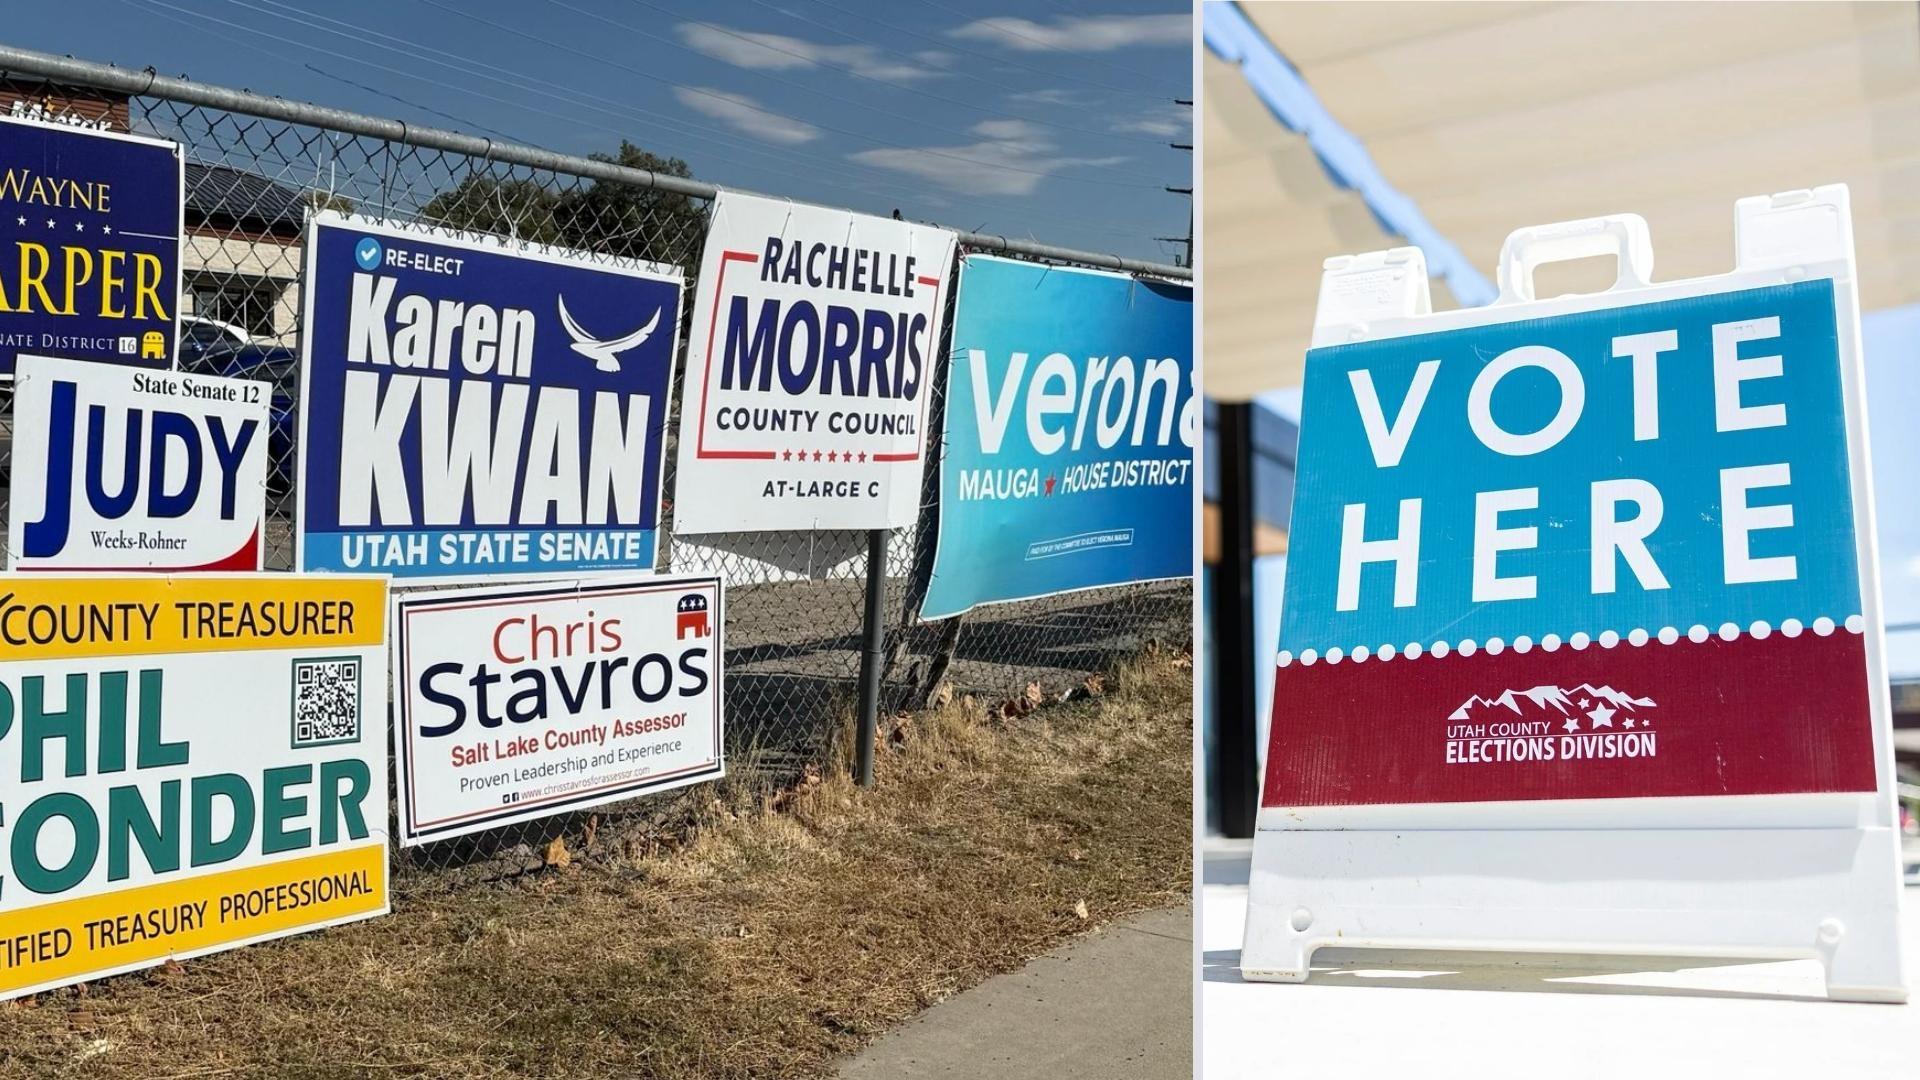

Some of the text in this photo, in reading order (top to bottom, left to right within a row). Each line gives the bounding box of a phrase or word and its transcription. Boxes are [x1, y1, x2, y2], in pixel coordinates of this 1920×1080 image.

[0, 168, 111, 212] WAYNE
[386, 248, 464, 277] RE-ELECT
[760, 236, 916, 298] RACHELLE
[42, 333, 115, 350] DISTRICT
[121, 339, 136, 352] 16
[347, 272, 535, 378] Karen
[720, 295, 927, 401] MORRIS
[133, 373, 260, 404] State Senate 12
[1348, 315, 1788, 468] VOTE
[338, 369, 651, 526] KWAN
[716, 406, 916, 435] COUNTY COUNCIL
[23, 380, 259, 558] JUDY
[763, 480, 879, 498] AT-LARGE C
[959, 459, 1191, 501] MAUGA HOUSE DISTRICT
[91, 530, 187, 550] Weeks-Rohner
[341, 531, 640, 568] UTAH STATE SENATE
[1335, 462, 1798, 612] HERE
[1, 601, 354, 646] COUNTY TREASURER
[493, 610, 622, 664] Chris
[419, 647, 709, 738] Stavros
[451, 712, 688, 768] Salt Lake County Assessor
[1446, 733, 1656, 764] ELECTIONS DIVISION
[1447, 721, 1551, 739] UTAH COUNTY
[460, 739, 682, 793] Proven Leadership and Experience
[0, 759, 371, 895] ONDER
[84, 901, 208, 951] TREASURY
[220, 870, 373, 923] PROFESSIONAL
